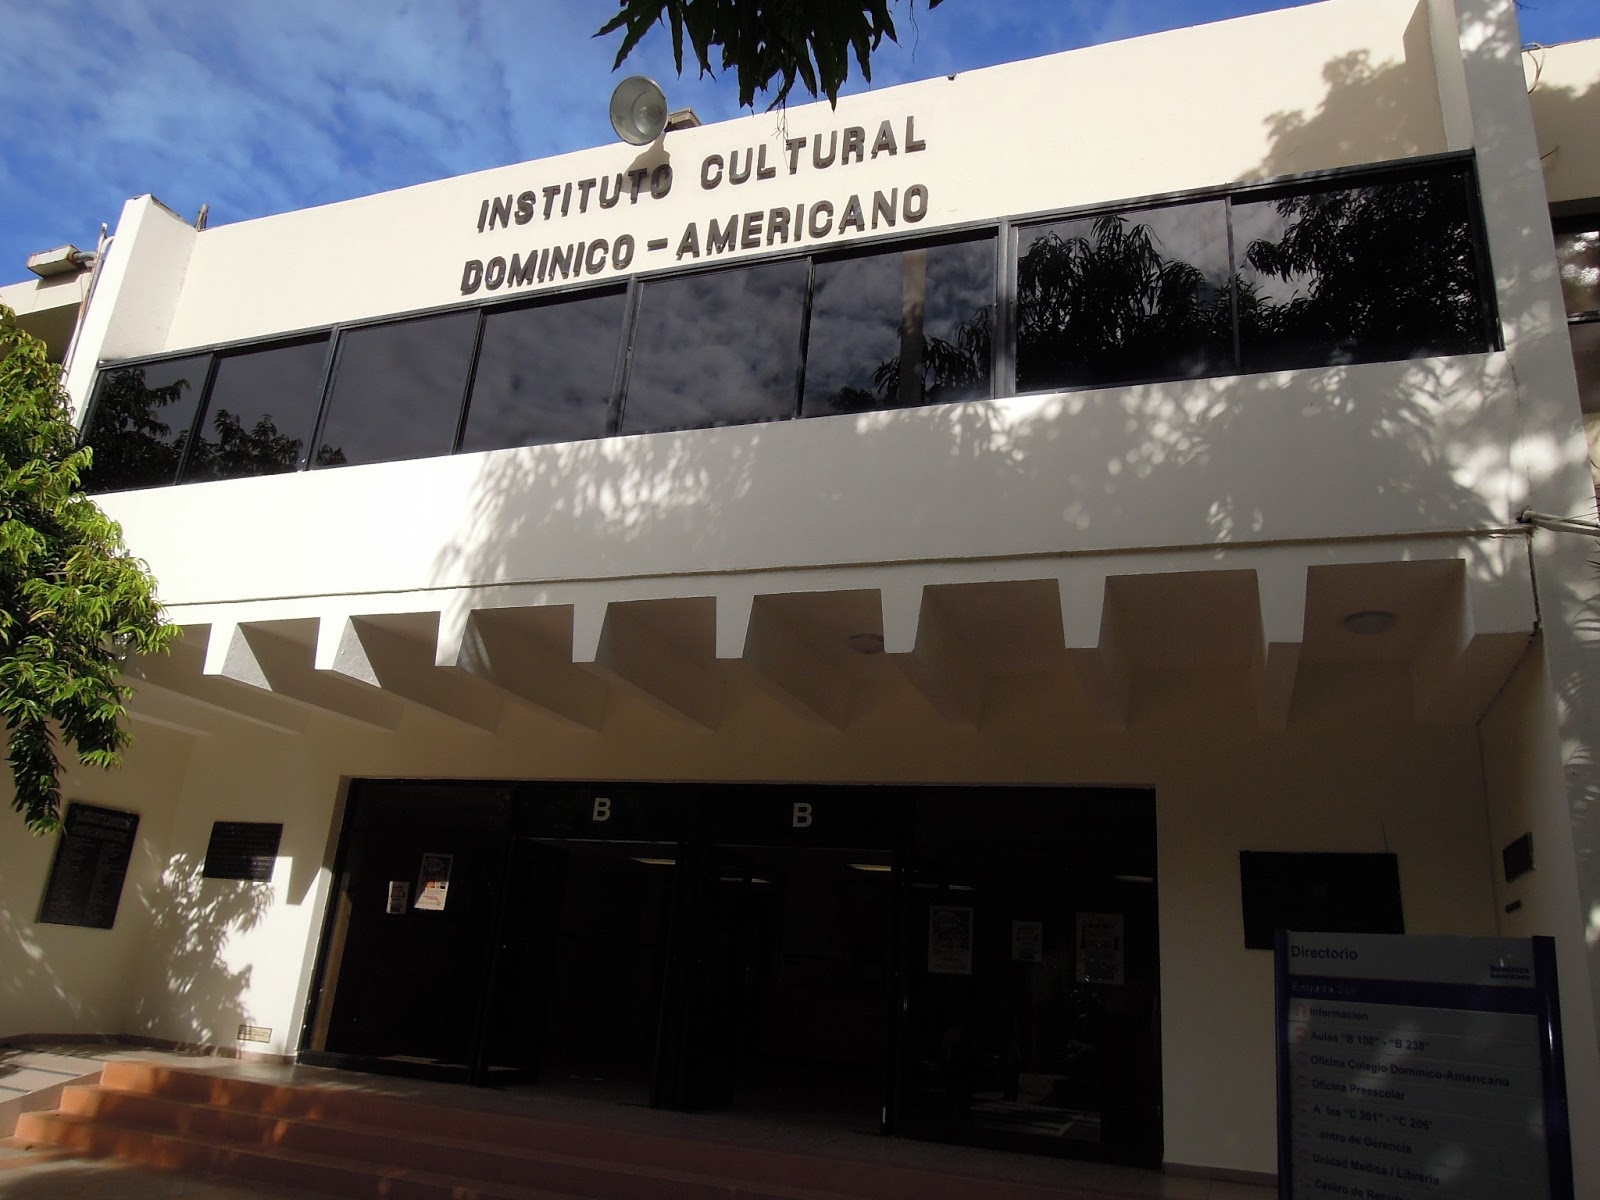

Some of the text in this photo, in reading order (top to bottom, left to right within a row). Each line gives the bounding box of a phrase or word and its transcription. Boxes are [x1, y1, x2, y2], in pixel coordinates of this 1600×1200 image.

[477, 115, 927, 233] INSTITUTO CULTURAL
[592, 797, 612, 822] B
[792, 802, 813, 828] B
[1291, 945, 1358, 961] Directorio
[1311, 1032, 1338, 1043] Aulas
[1311, 1055, 1346, 1069] Oficina
[1348, 1059, 1388, 1074] Colegio
[1312, 1079, 1405, 1100] Oficina Preescolar
[1348, 1134, 1360, 1145] de
[1364, 1137, 1412, 1154] Gerencia
[1313, 1153, 1348, 1168] Unidad
[1314, 1179, 1348, 1195] Centro
[1351, 1185, 1364, 1198] de
